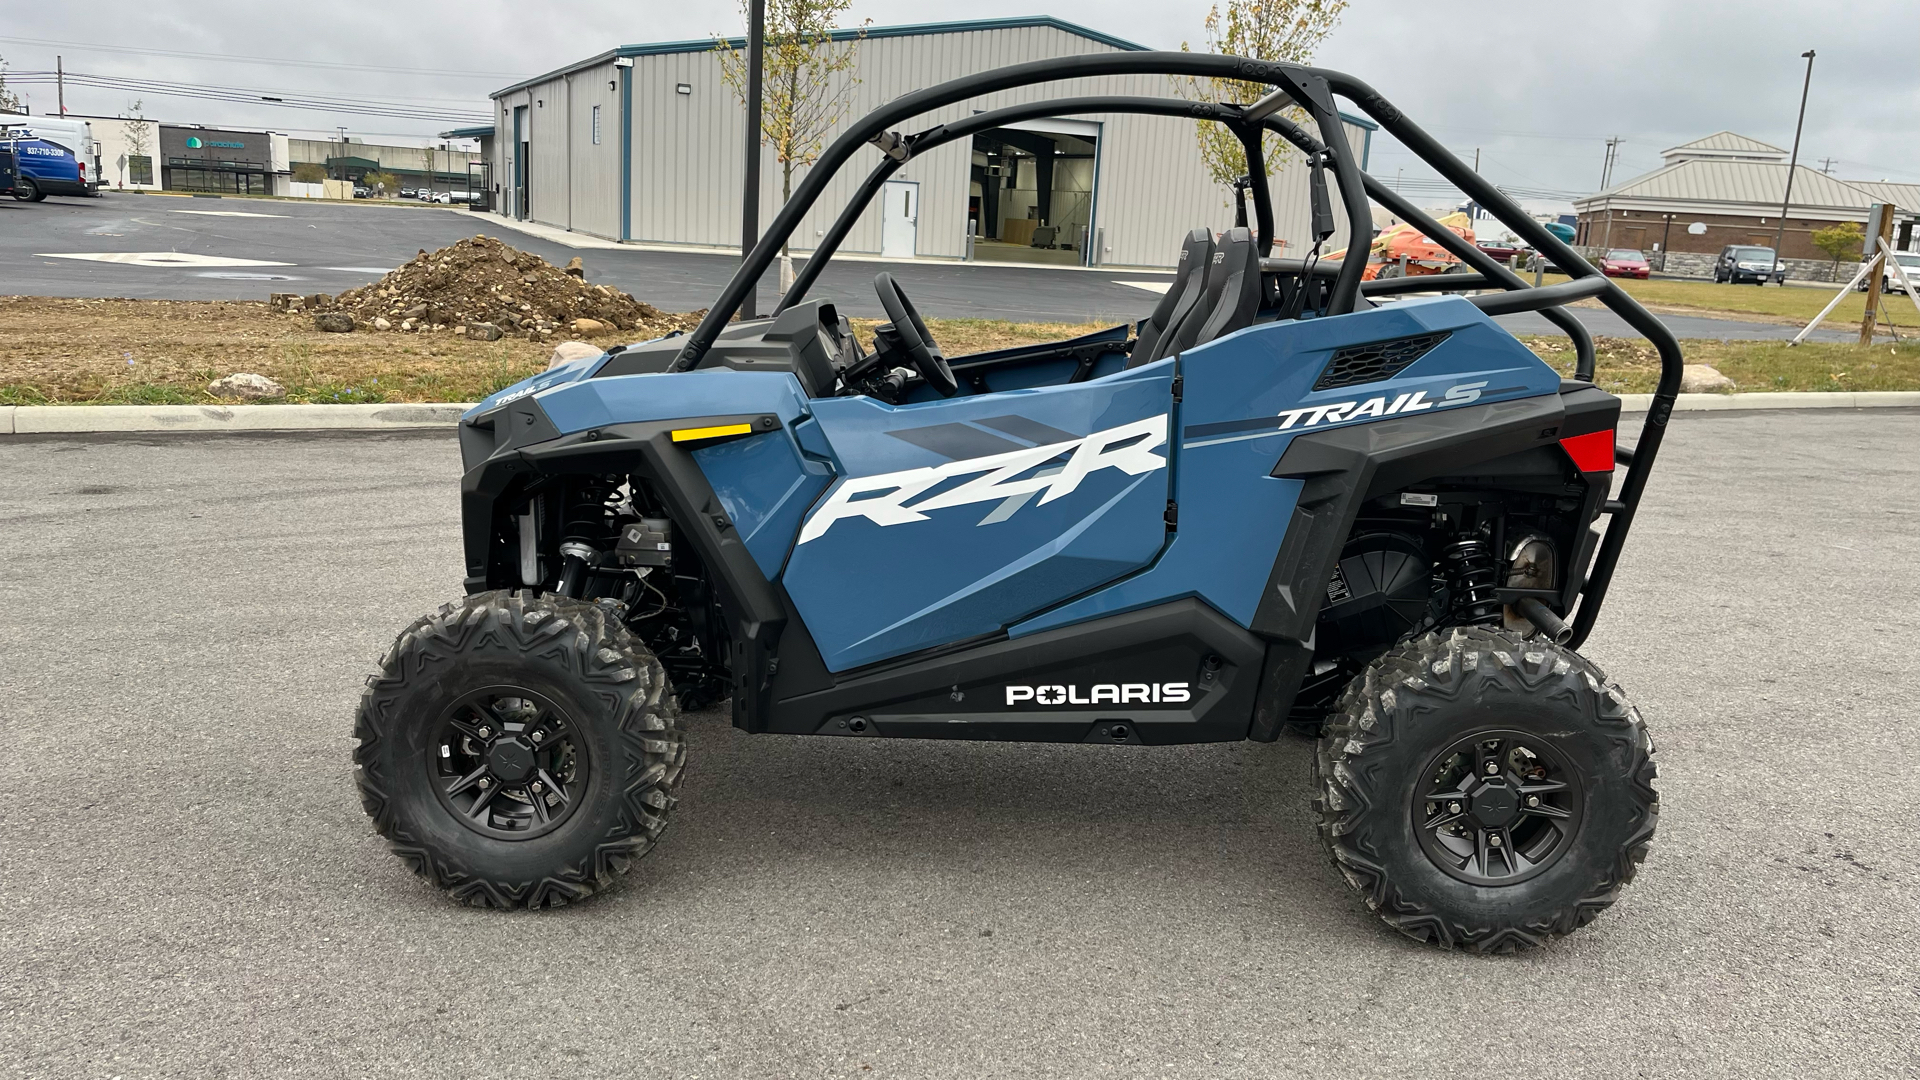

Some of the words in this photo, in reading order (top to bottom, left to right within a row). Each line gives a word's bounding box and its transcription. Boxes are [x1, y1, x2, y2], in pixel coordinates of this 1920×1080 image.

[495, 386, 537, 406] TRAIL
[537, 380, 552, 391] S
[1278, 391, 1433, 430] TRAIL
[1437, 381, 1489, 407] S
[798, 413, 1168, 546] RZR
[1006, 682, 1191, 706] POLARIS
